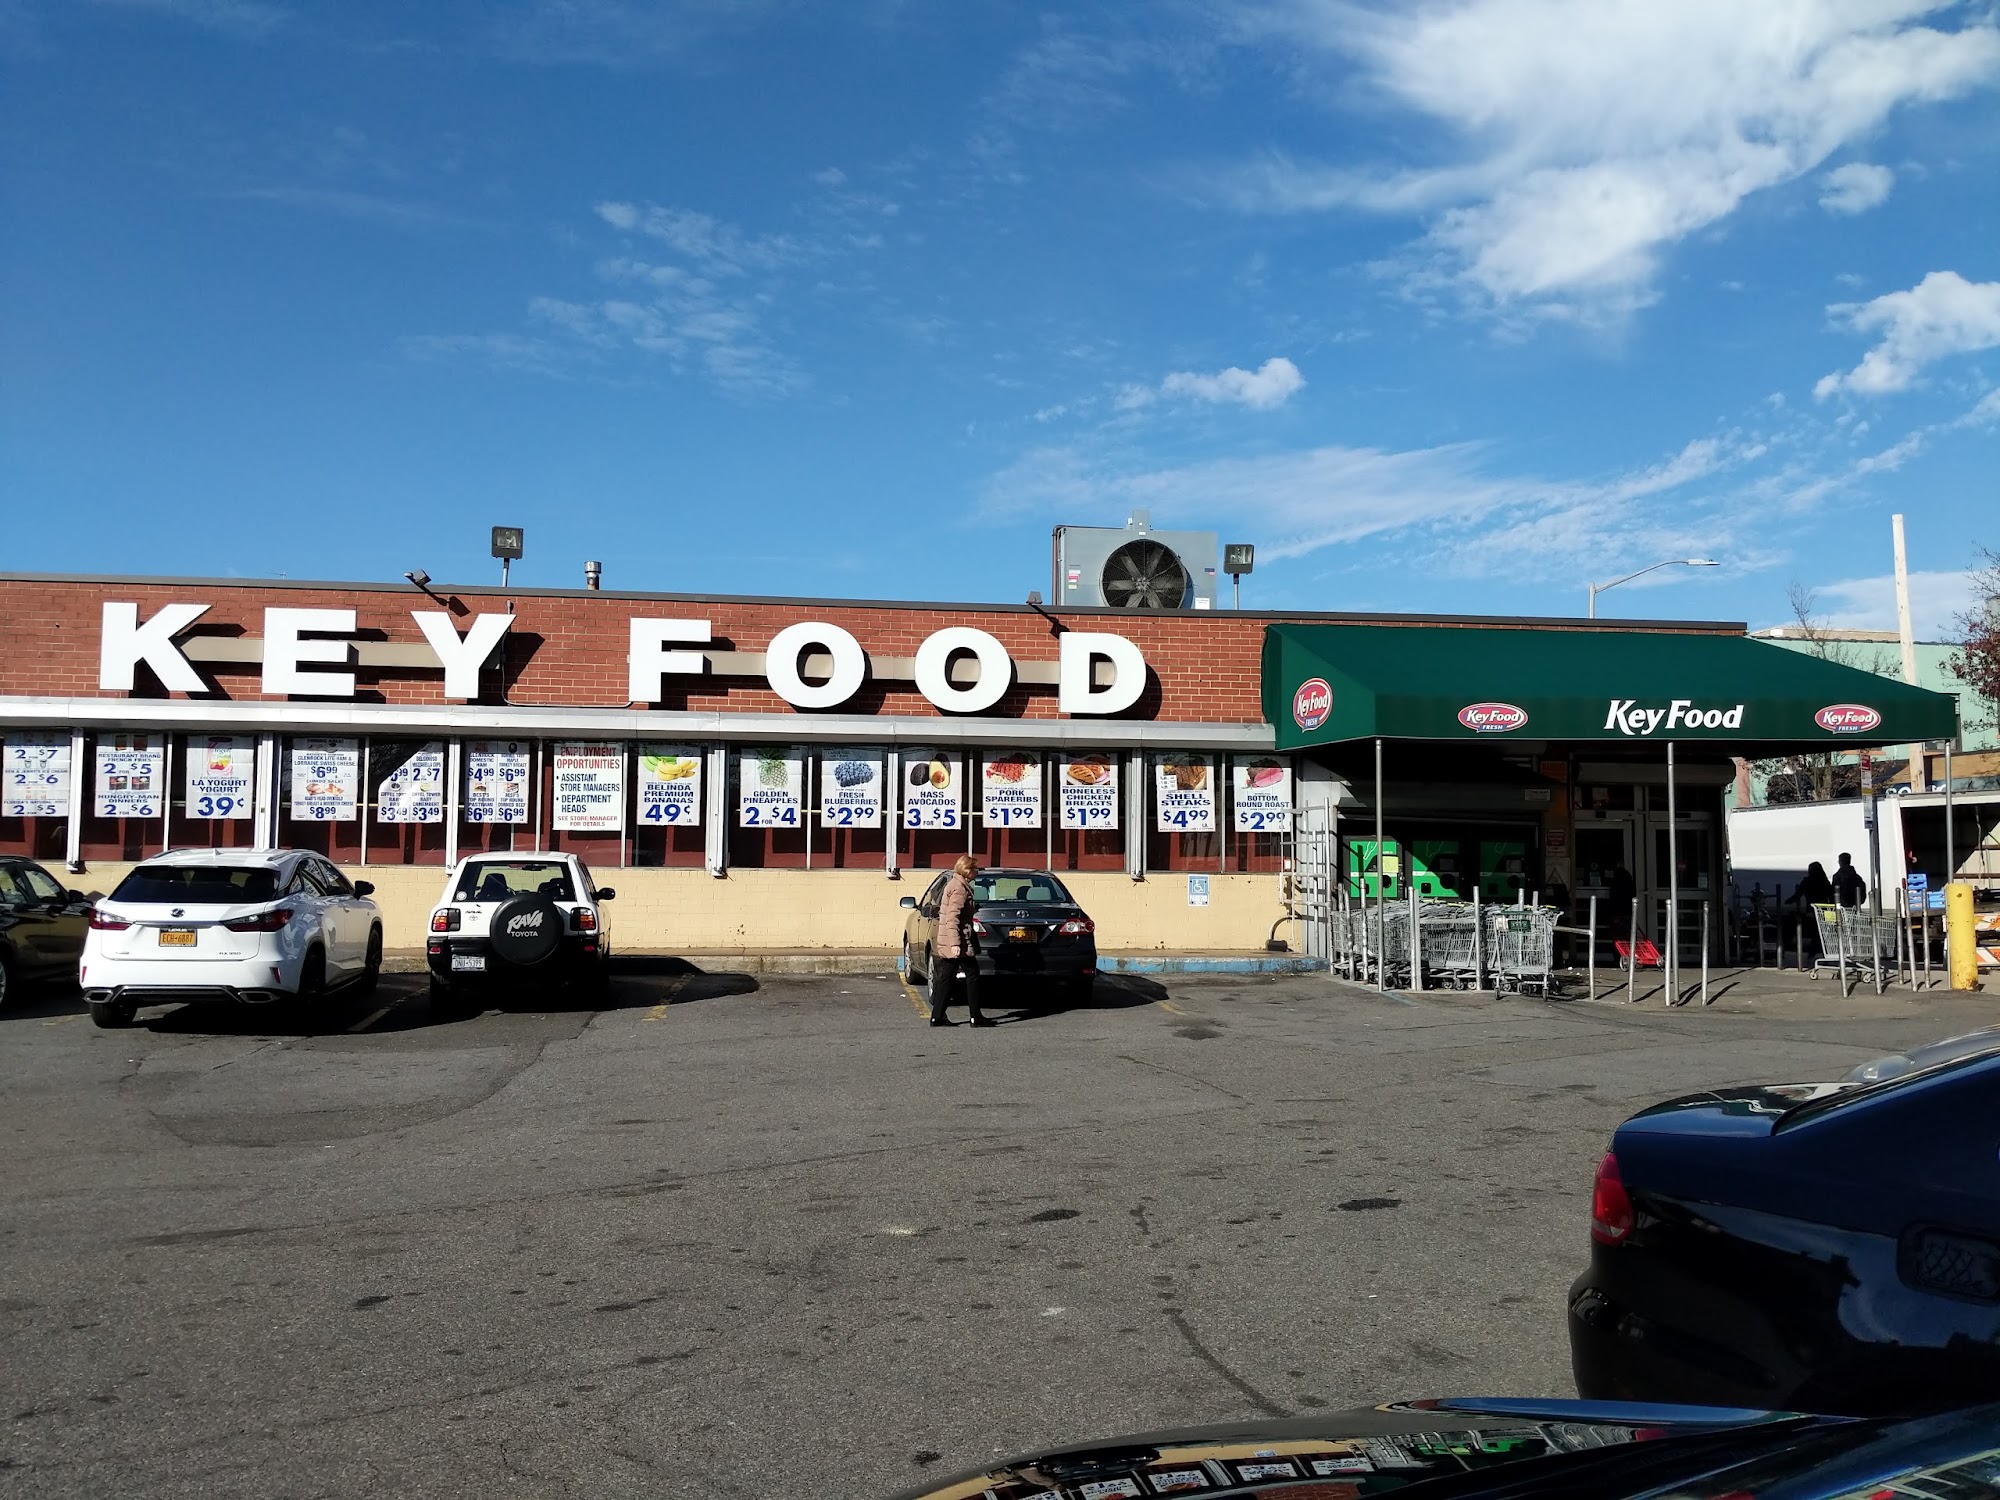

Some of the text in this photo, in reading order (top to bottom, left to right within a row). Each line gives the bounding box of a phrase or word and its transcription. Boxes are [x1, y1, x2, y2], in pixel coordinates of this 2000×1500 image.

[100, 601, 1147, 714] KEY FOOD
[1603, 700, 1744, 736] Key Food
[14, 749, 26, 759] 2
[560, 746, 616, 757] EMPLOYMENT
[104, 763, 116, 774] 2
[131, 763, 152, 774] $5
[557, 758, 620, 769] OPPORTUNITIES
[14, 774, 26, 784] 2
[413, 768, 420, 781] 2
[500, 768, 526, 781] $699
[562, 774, 597, 782] ASSISTANT
[560, 783, 620, 791] STORE MANAGERS
[562, 795, 612, 803] DEPARTMENT
[13, 805, 24, 814] 2
[104, 804, 117, 815] 2
[131, 804, 153, 815] $6
[468, 808, 493, 821] $699
[499, 808, 524, 821] $699
[746, 807, 759, 824] 2
[772, 806, 796, 825] $4
[827, 806, 874, 825] $299
[990, 807, 1034, 825] $199
[1067, 807, 1110, 825] $199
[907, 808, 921, 826] 3
[933, 808, 956, 826] $5
[1163, 810, 1208, 827] $499
